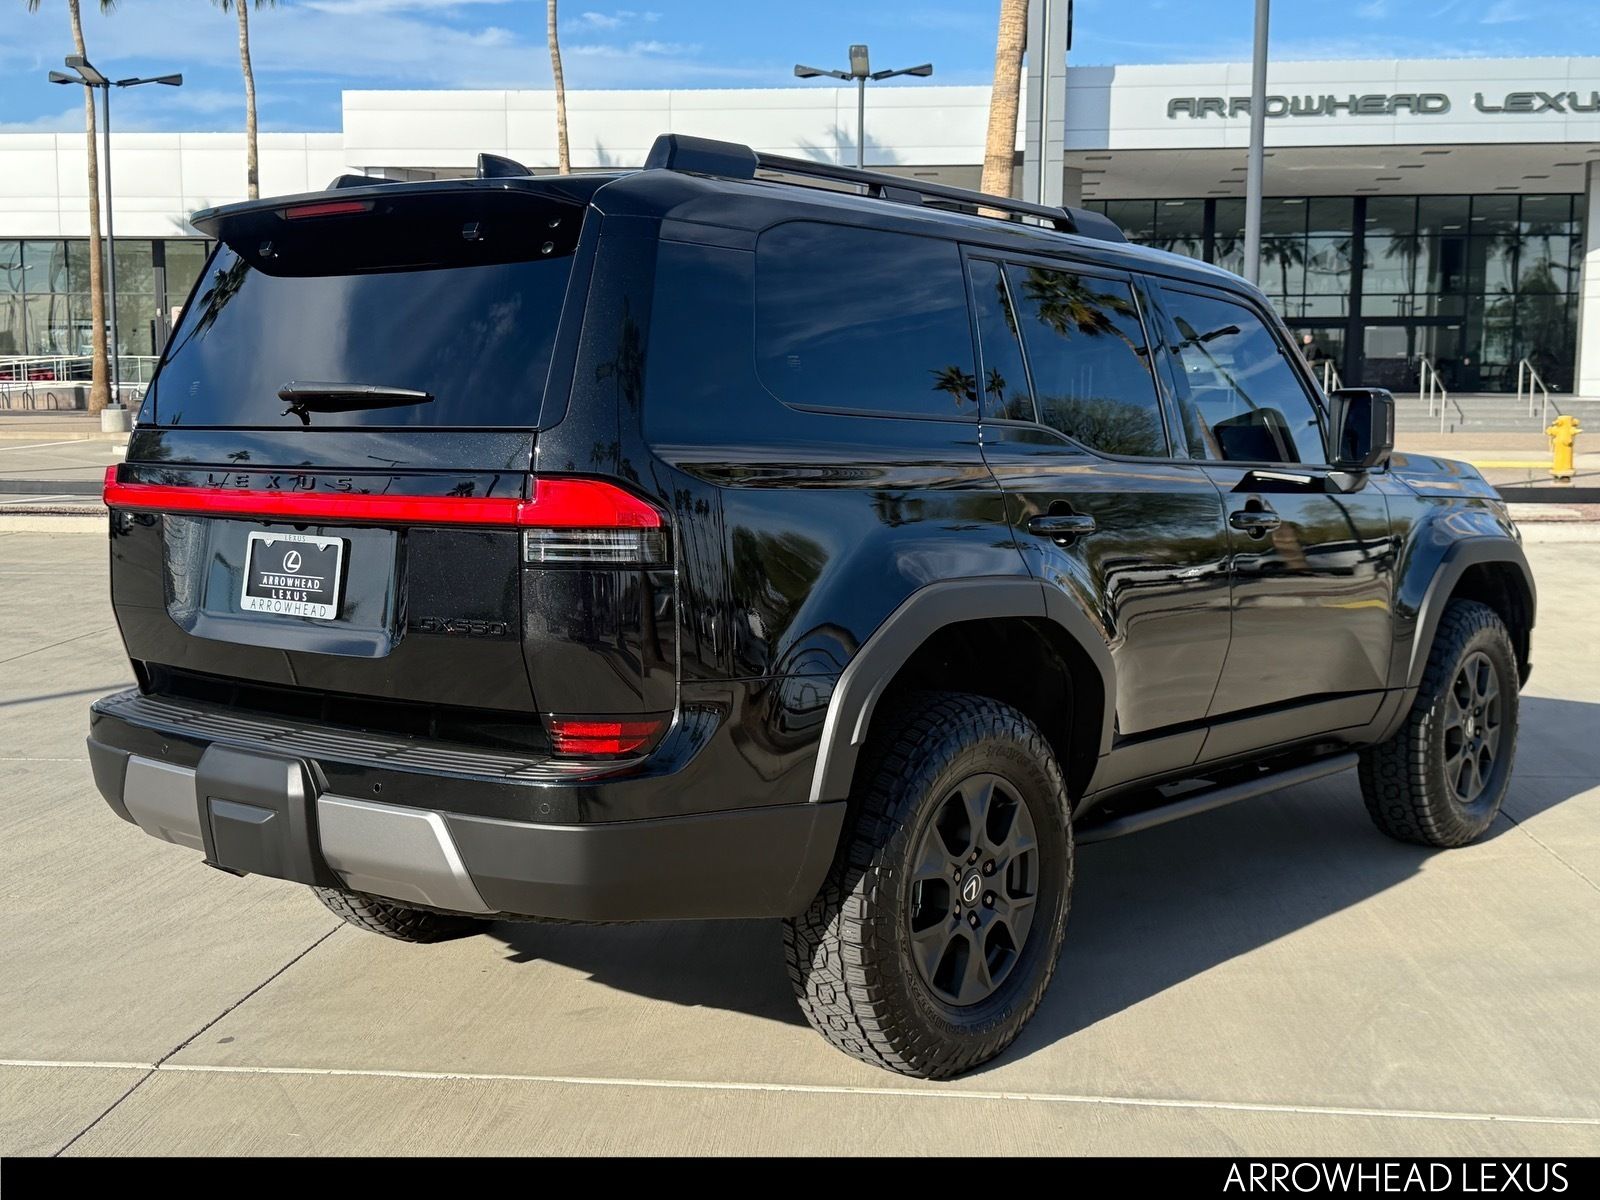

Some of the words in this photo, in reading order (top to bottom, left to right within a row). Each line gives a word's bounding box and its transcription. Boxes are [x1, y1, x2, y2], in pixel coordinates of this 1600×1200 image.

[1167, 94, 1450, 119] ARROWHEAD
[1474, 91, 1600, 114] LEXU
[206, 473, 353, 492] LEXUS
[284, 534, 306, 543] LEXUS
[262, 575, 320, 590] ARROWHEAD
[271, 589, 308, 602] LEXUS
[250, 598, 327, 618] ARROWHEAD
